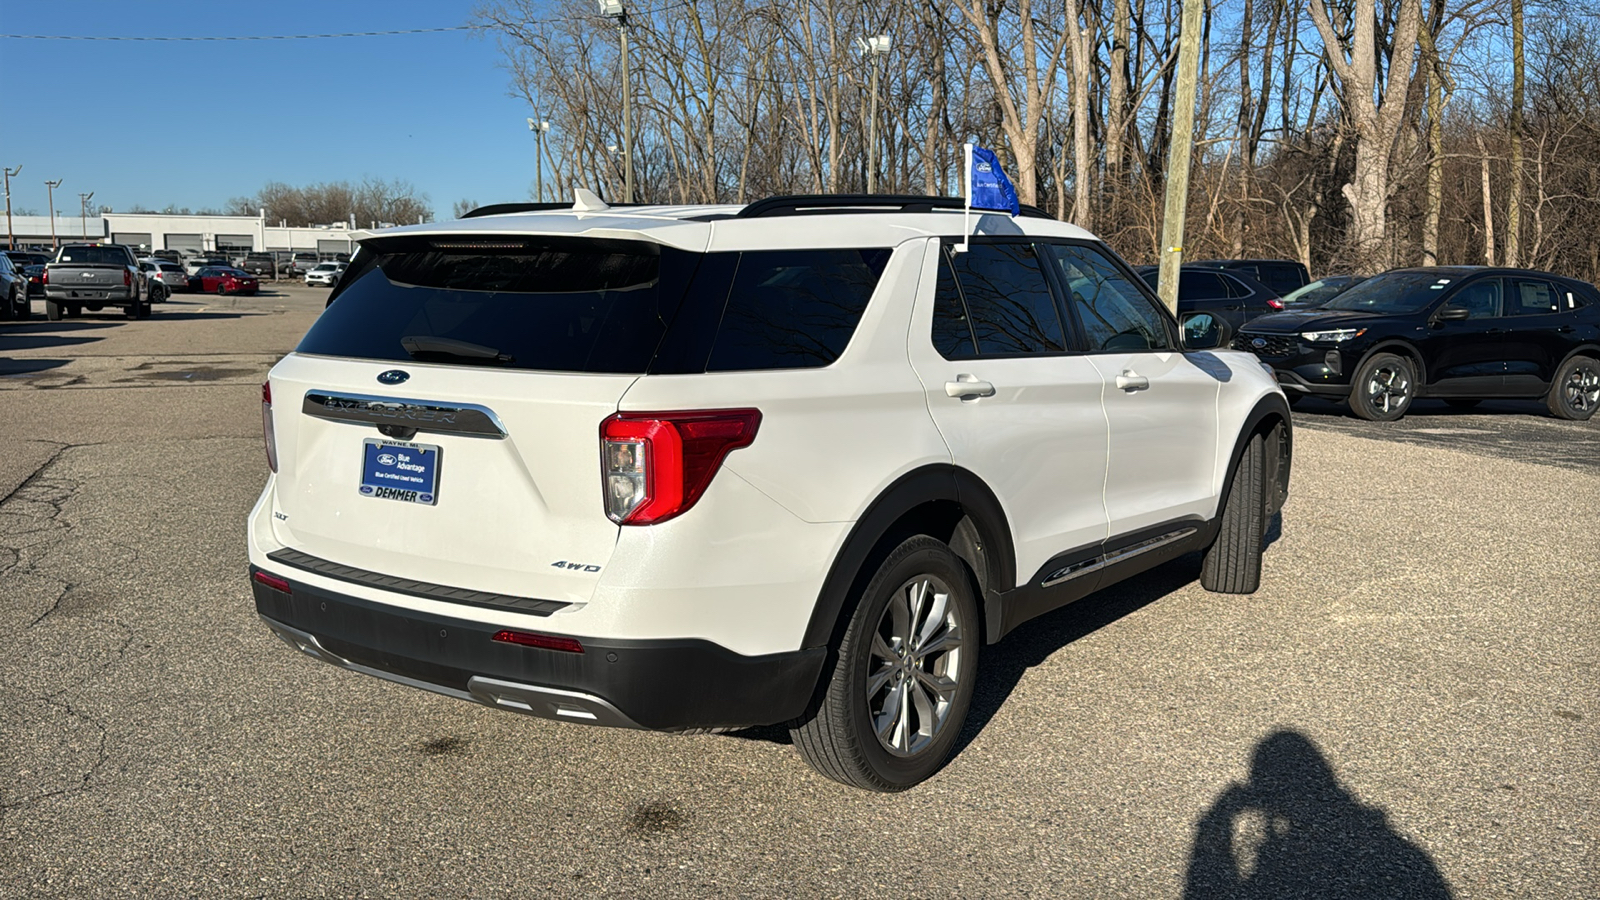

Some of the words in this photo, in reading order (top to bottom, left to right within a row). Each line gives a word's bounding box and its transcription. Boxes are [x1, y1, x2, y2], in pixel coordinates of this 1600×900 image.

[324, 400, 456, 423] EXPLORER
[397, 453, 411, 462] Blue
[397, 462, 425, 473] Advantage
[375, 487, 418, 502] DEMMER
[274, 511, 289, 521] XLT
[551, 561, 602, 572] 4WD
